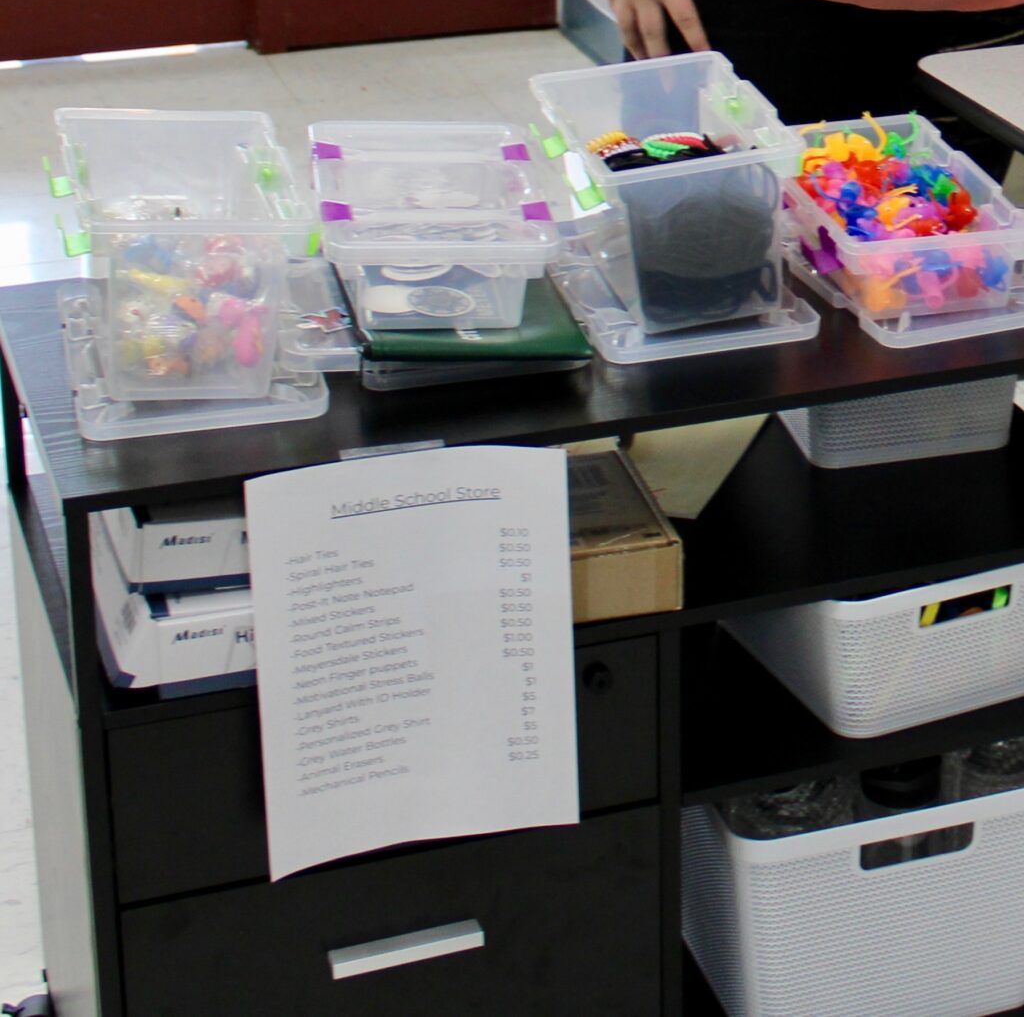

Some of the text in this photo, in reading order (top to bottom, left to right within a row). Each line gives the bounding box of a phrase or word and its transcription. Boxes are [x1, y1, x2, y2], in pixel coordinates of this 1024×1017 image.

[331, 485, 500, 517] Middle School Store
[315, 550, 338, 558] Ties
[324, 564, 348, 574] Hair
[351, 559, 375, 568] Ties
[332, 593, 360, 603] Note
[363, 583, 414, 598] Notepad
[329, 606, 376, 620] Stickers
[335, 623, 364, 634] Calm
[368, 617, 401, 628] Strips
[326, 636, 376, 651] Textured
[379, 628, 424, 642] Stickers
[362, 646, 408, 660] Stickers
[330, 668, 366, 681] Finger
[369, 677, 404, 689] Stress
[407, 671, 435, 683] Balls
[392, 688, 431, 699] Holder
[327, 716, 359, 729] Shirts
[403, 718, 431, 728] Shirt
[329, 745, 363, 758] Water
[366, 736, 407, 750] Bottles
[344, 756, 384, 770] Erasers
[368, 765, 410, 779] Pencils
